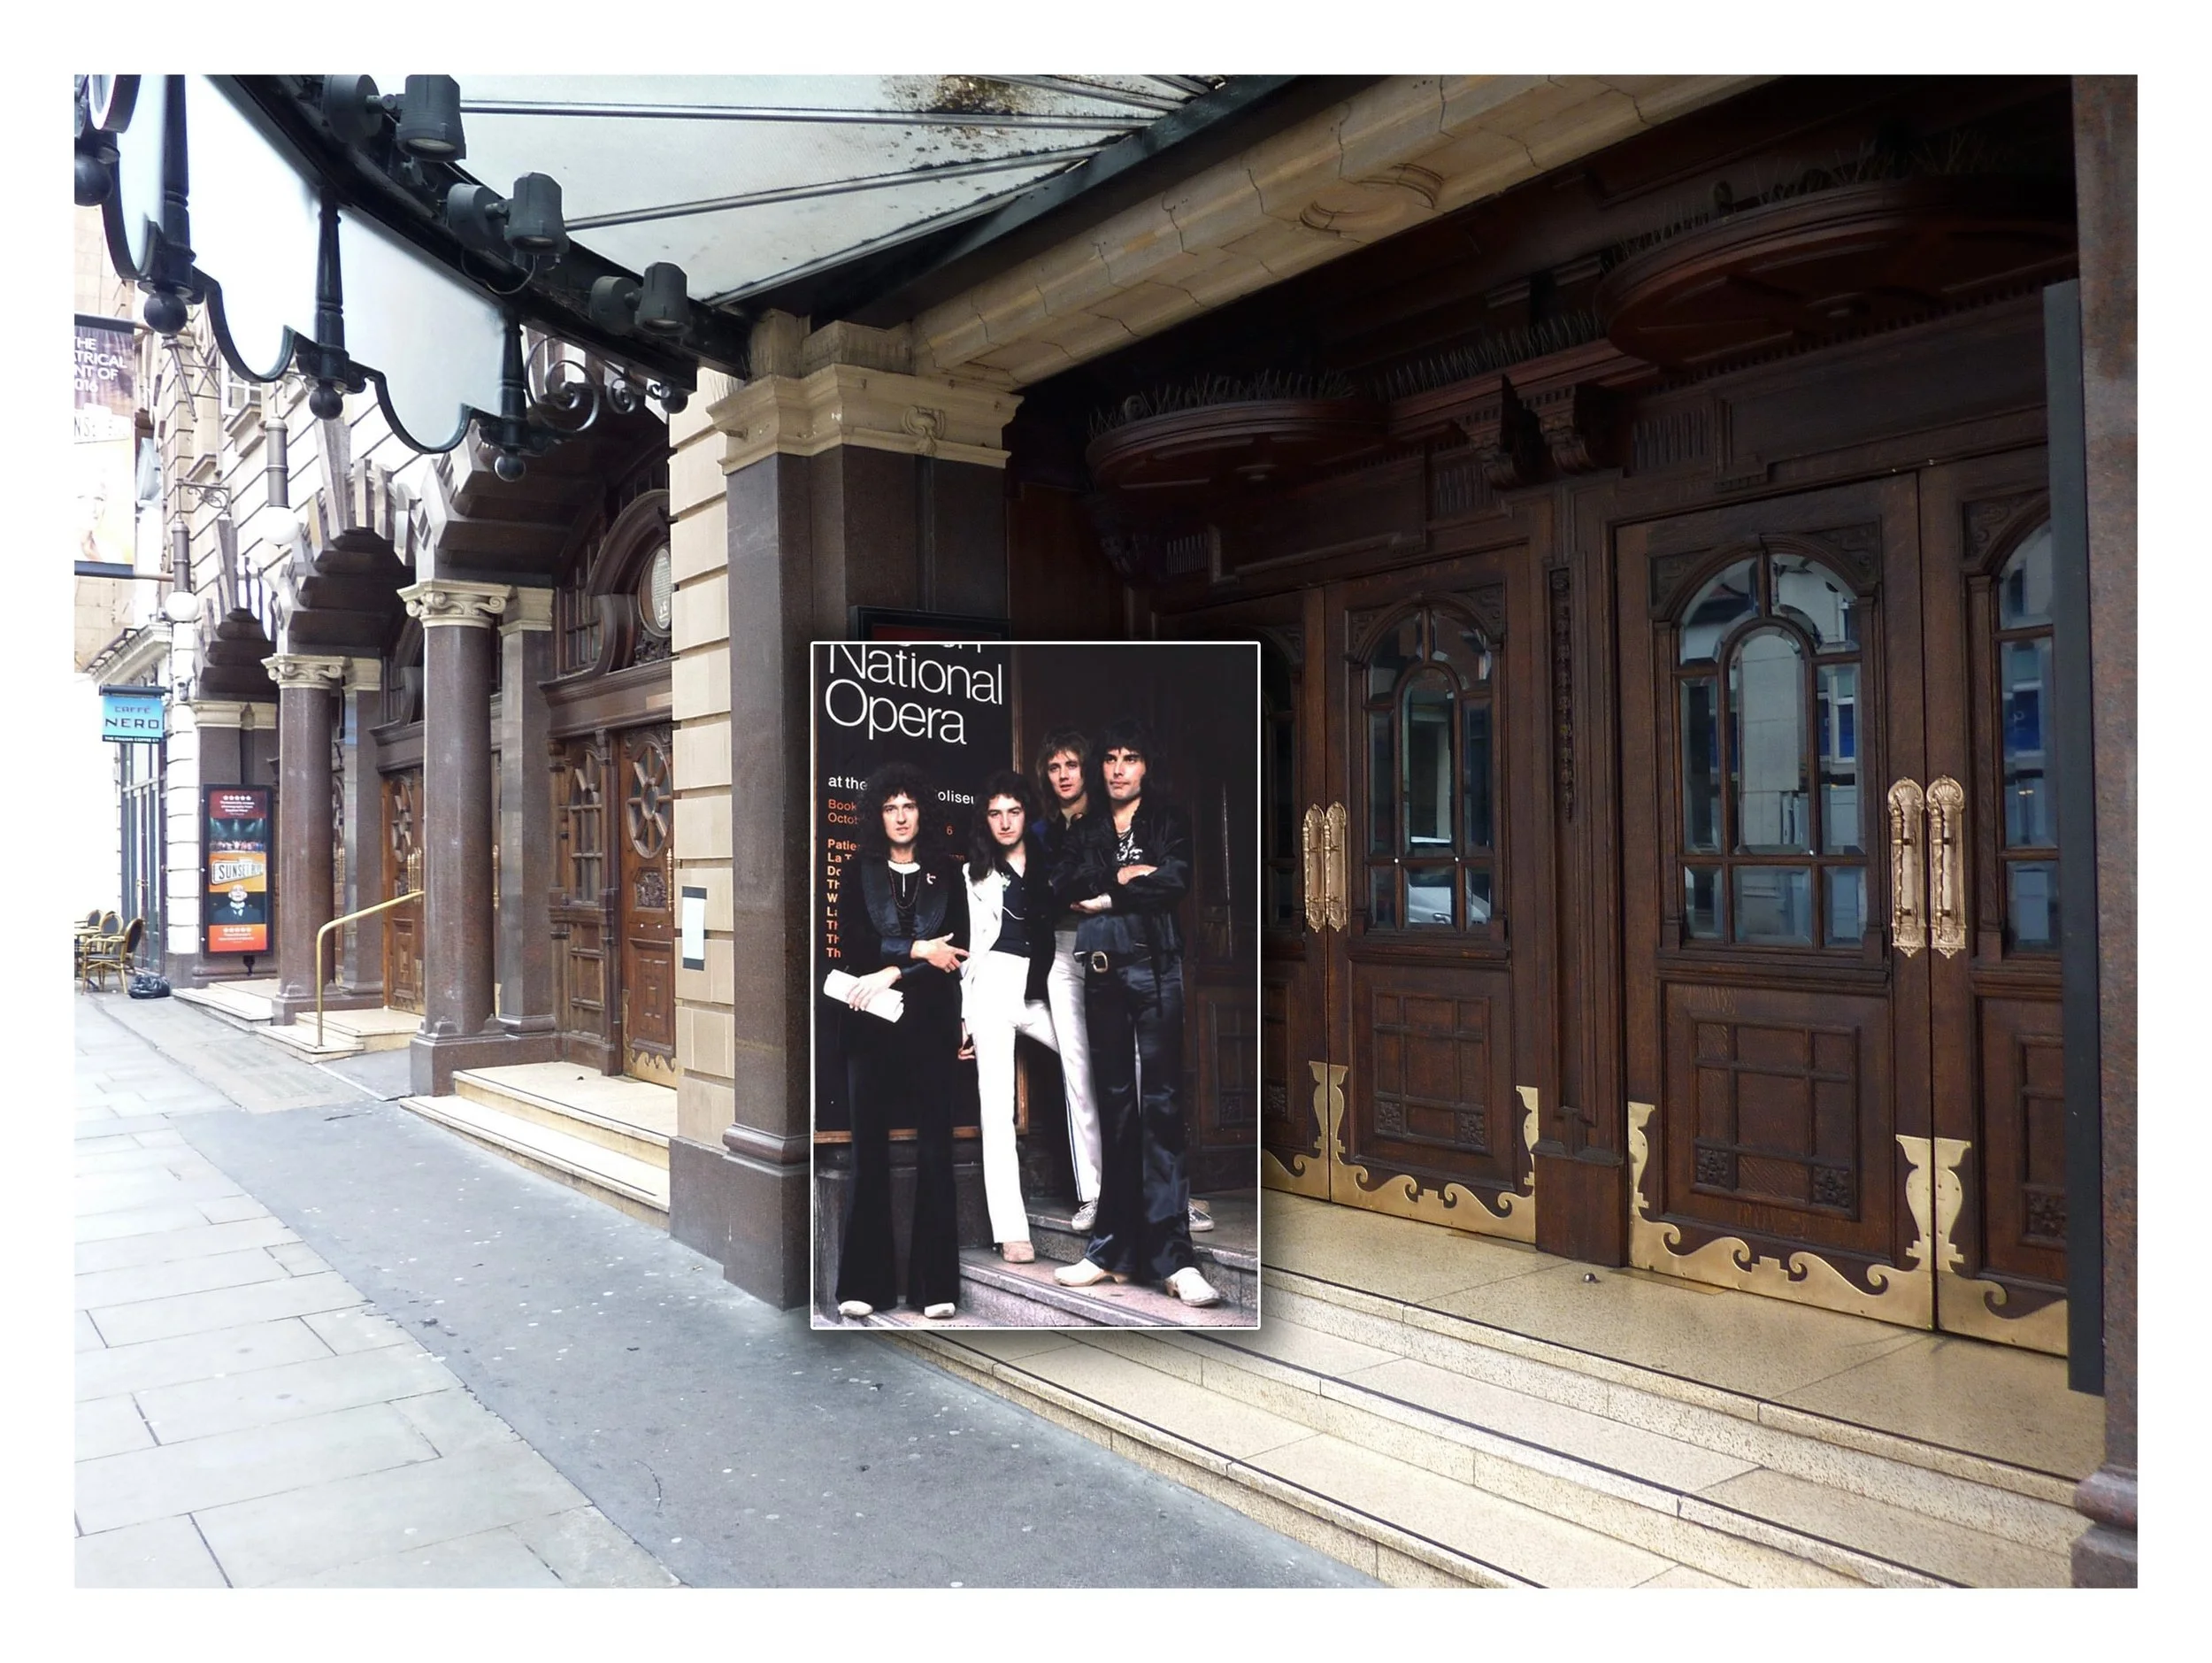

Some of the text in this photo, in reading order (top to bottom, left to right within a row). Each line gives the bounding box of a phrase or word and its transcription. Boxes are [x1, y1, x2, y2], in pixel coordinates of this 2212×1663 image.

[97, 367, 119, 381] OF
[829, 644, 1002, 704] National
[825, 678, 967, 745] Opera
[105, 718, 159, 729] NERO
[828, 775, 867, 790] at the
[827, 851, 842, 863] La
[826, 947, 841, 959] Th
